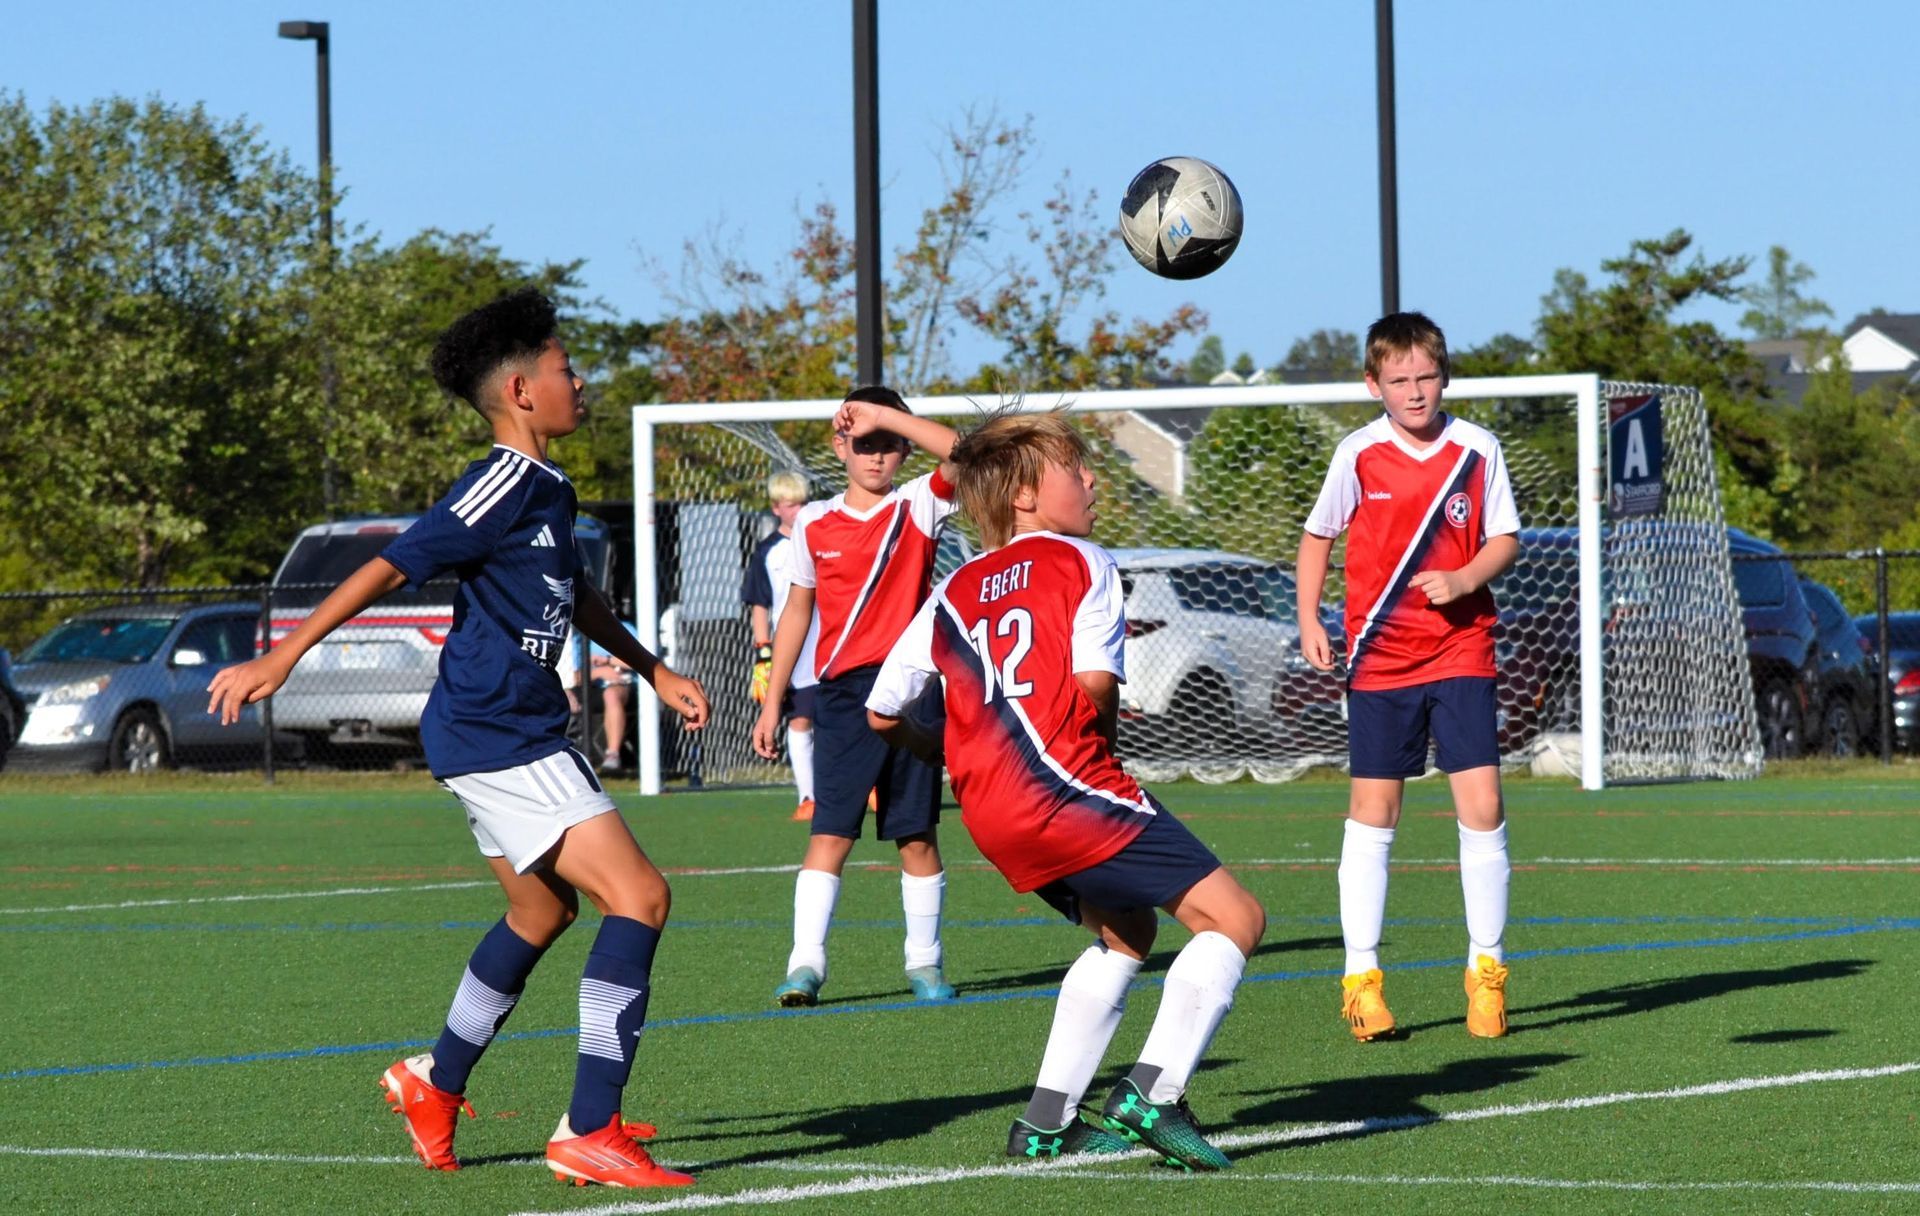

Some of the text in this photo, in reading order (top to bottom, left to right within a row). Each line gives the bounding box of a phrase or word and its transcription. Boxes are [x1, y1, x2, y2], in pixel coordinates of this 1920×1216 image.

[1623, 418, 1649, 480] A
[979, 560, 1033, 603] EBERT
[968, 606, 1034, 705] 12
